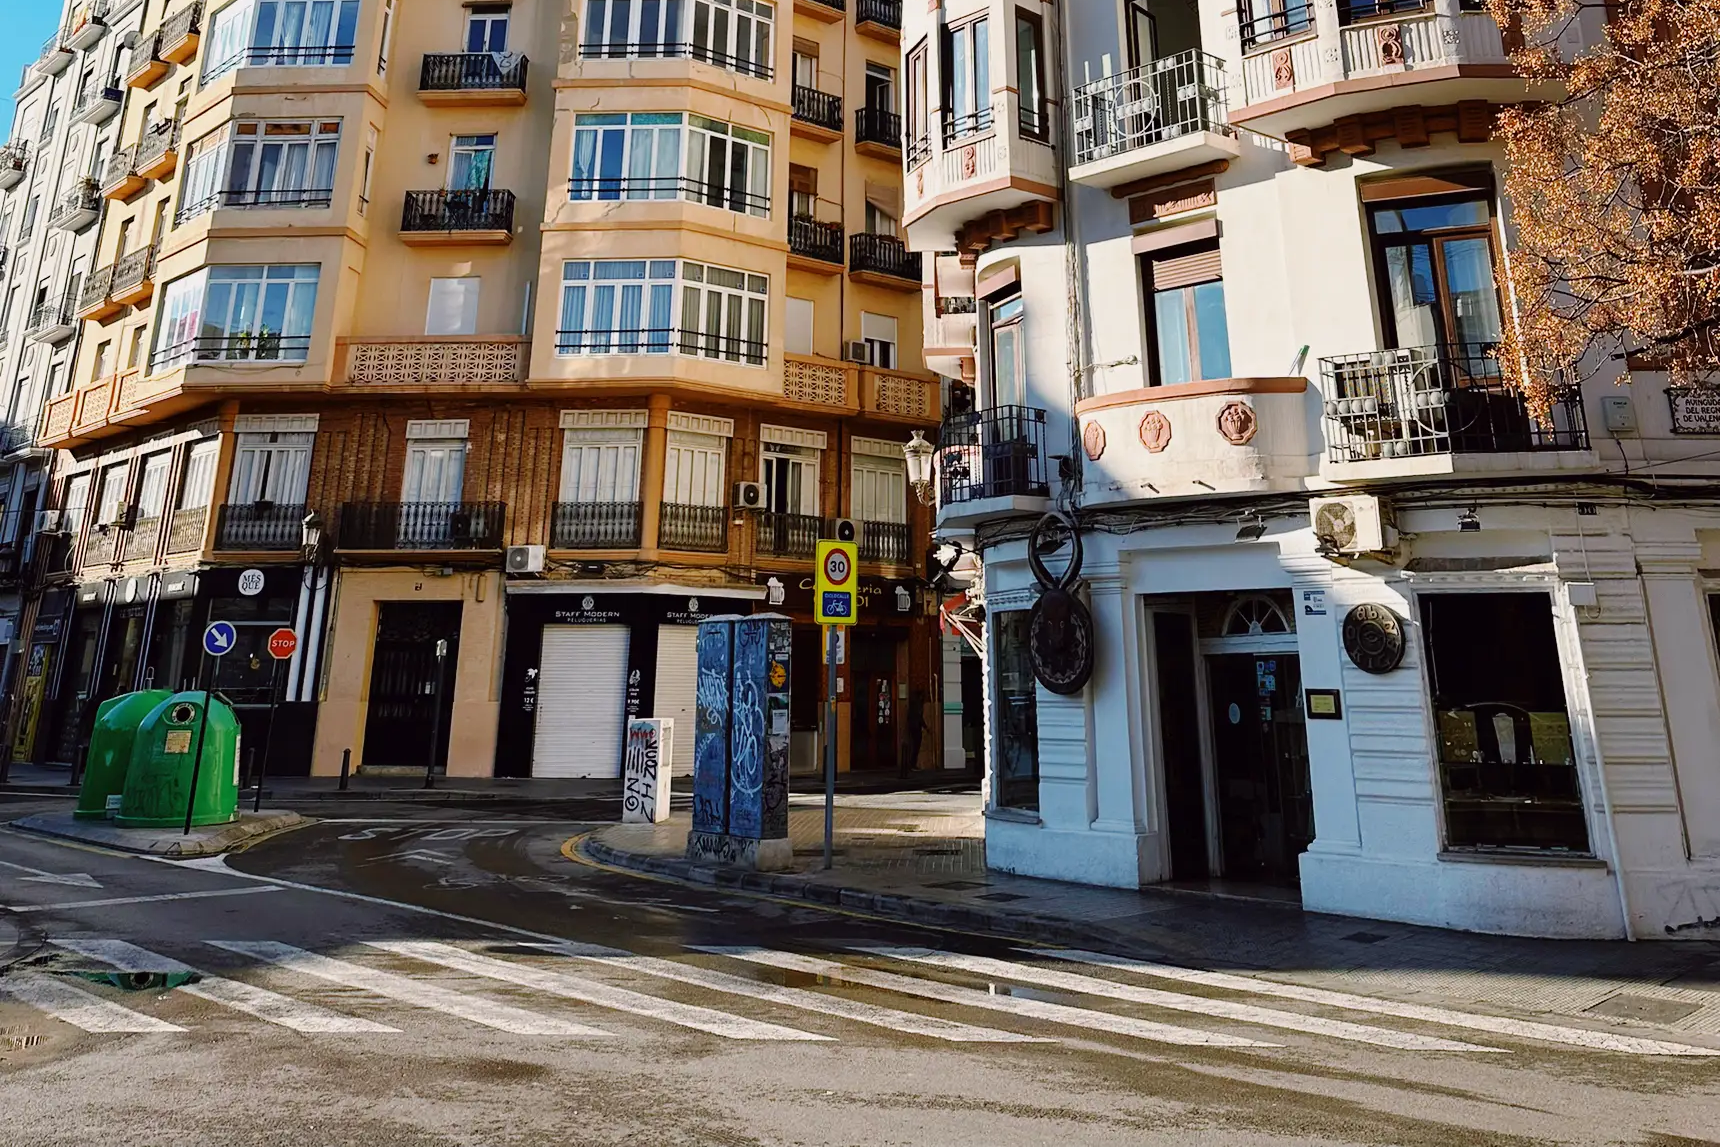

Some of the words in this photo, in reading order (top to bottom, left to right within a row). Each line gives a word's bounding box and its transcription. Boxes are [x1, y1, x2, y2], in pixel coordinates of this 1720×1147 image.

[1685, 398, 1720, 406] AVINGUD
[829, 560, 846, 573] 30
[271, 639, 295, 648] STOP
[338, 827, 519, 841] STOP
